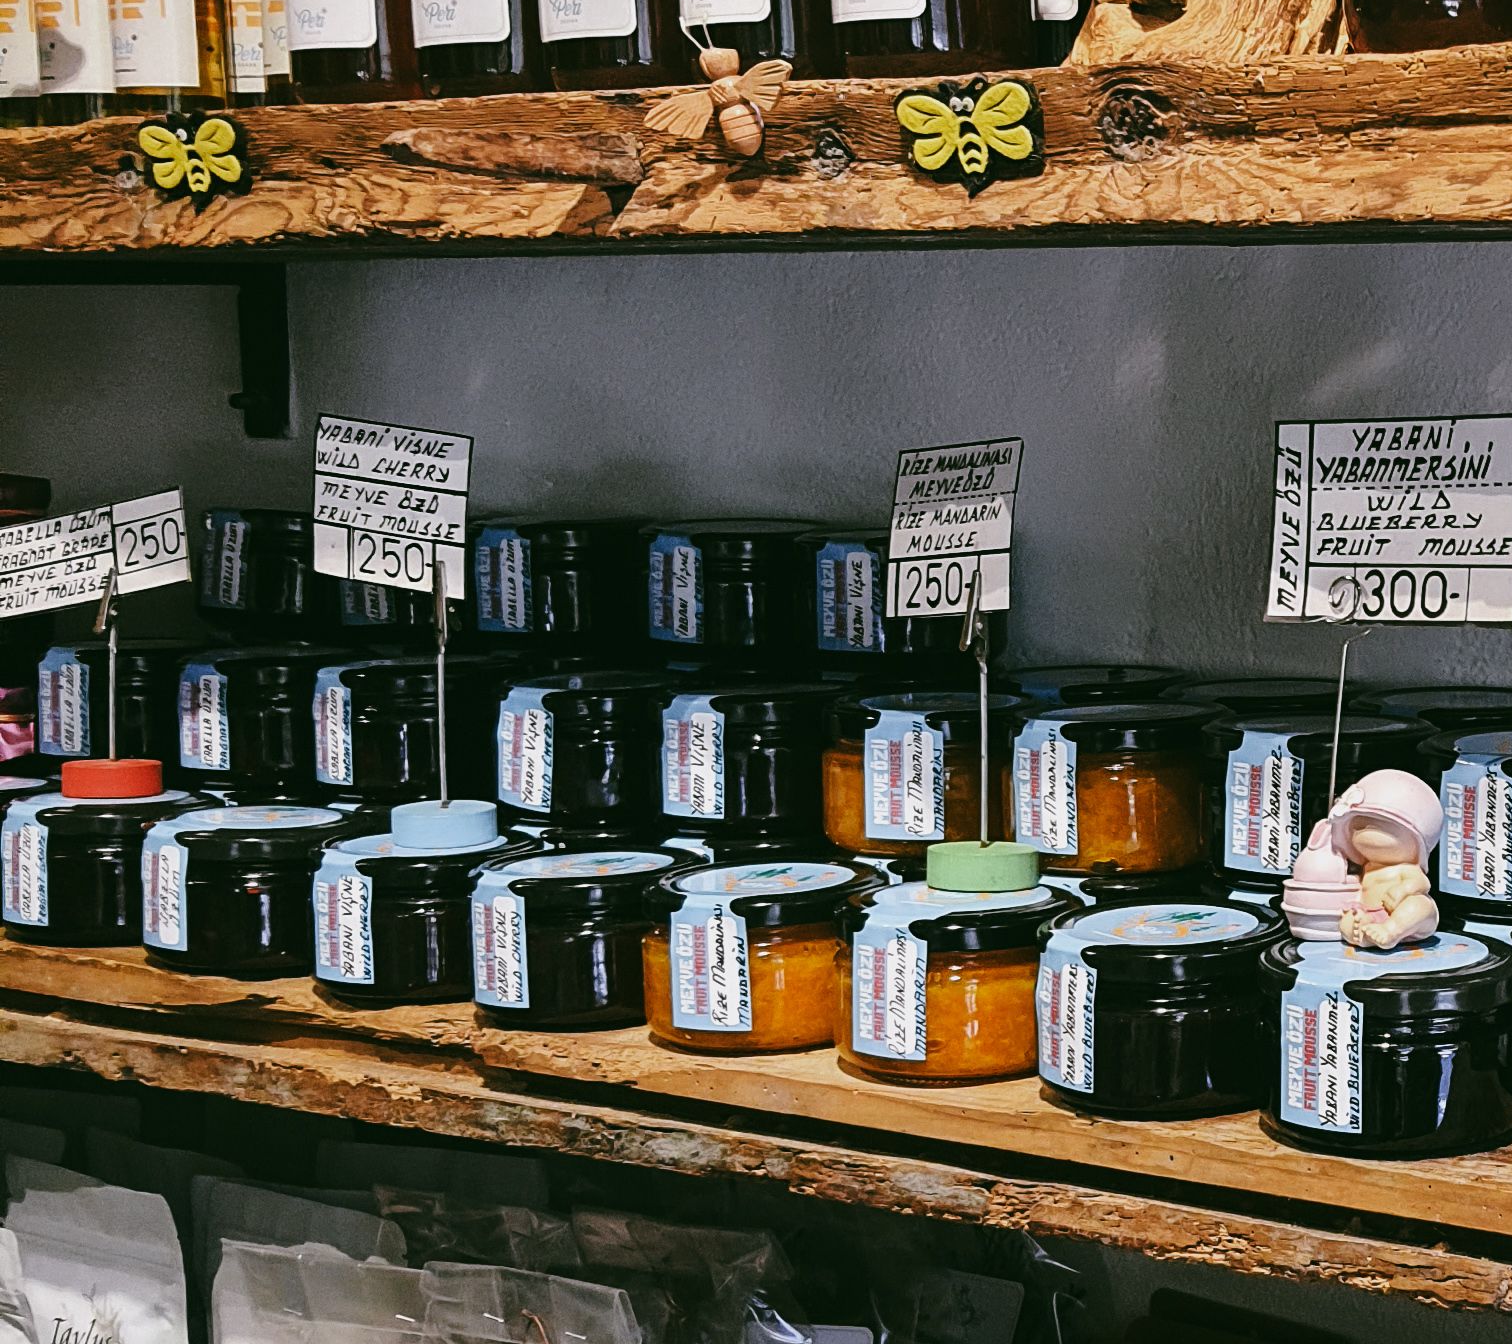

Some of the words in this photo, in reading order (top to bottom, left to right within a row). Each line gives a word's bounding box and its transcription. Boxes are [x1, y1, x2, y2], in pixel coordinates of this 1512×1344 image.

[372, 457, 450, 484] CHERRY
[1275, 447, 1302, 508] ÖZÜ
[321, 481, 390, 506] MEYVE
[379, 514, 461, 540] MOUSSE
[907, 531, 978, 553] MOUSSE
[1316, 513, 1483, 531] BLUEBERRY
[1277, 511, 1301, 611] MEYVE
[693, 925, 707, 976] MOUSSE
[1304, 1009, 1318, 1068] MOUSSE
[1287, 1045, 1303, 1109] MEYVE
[1303, 1069, 1318, 1111] FRUIT
